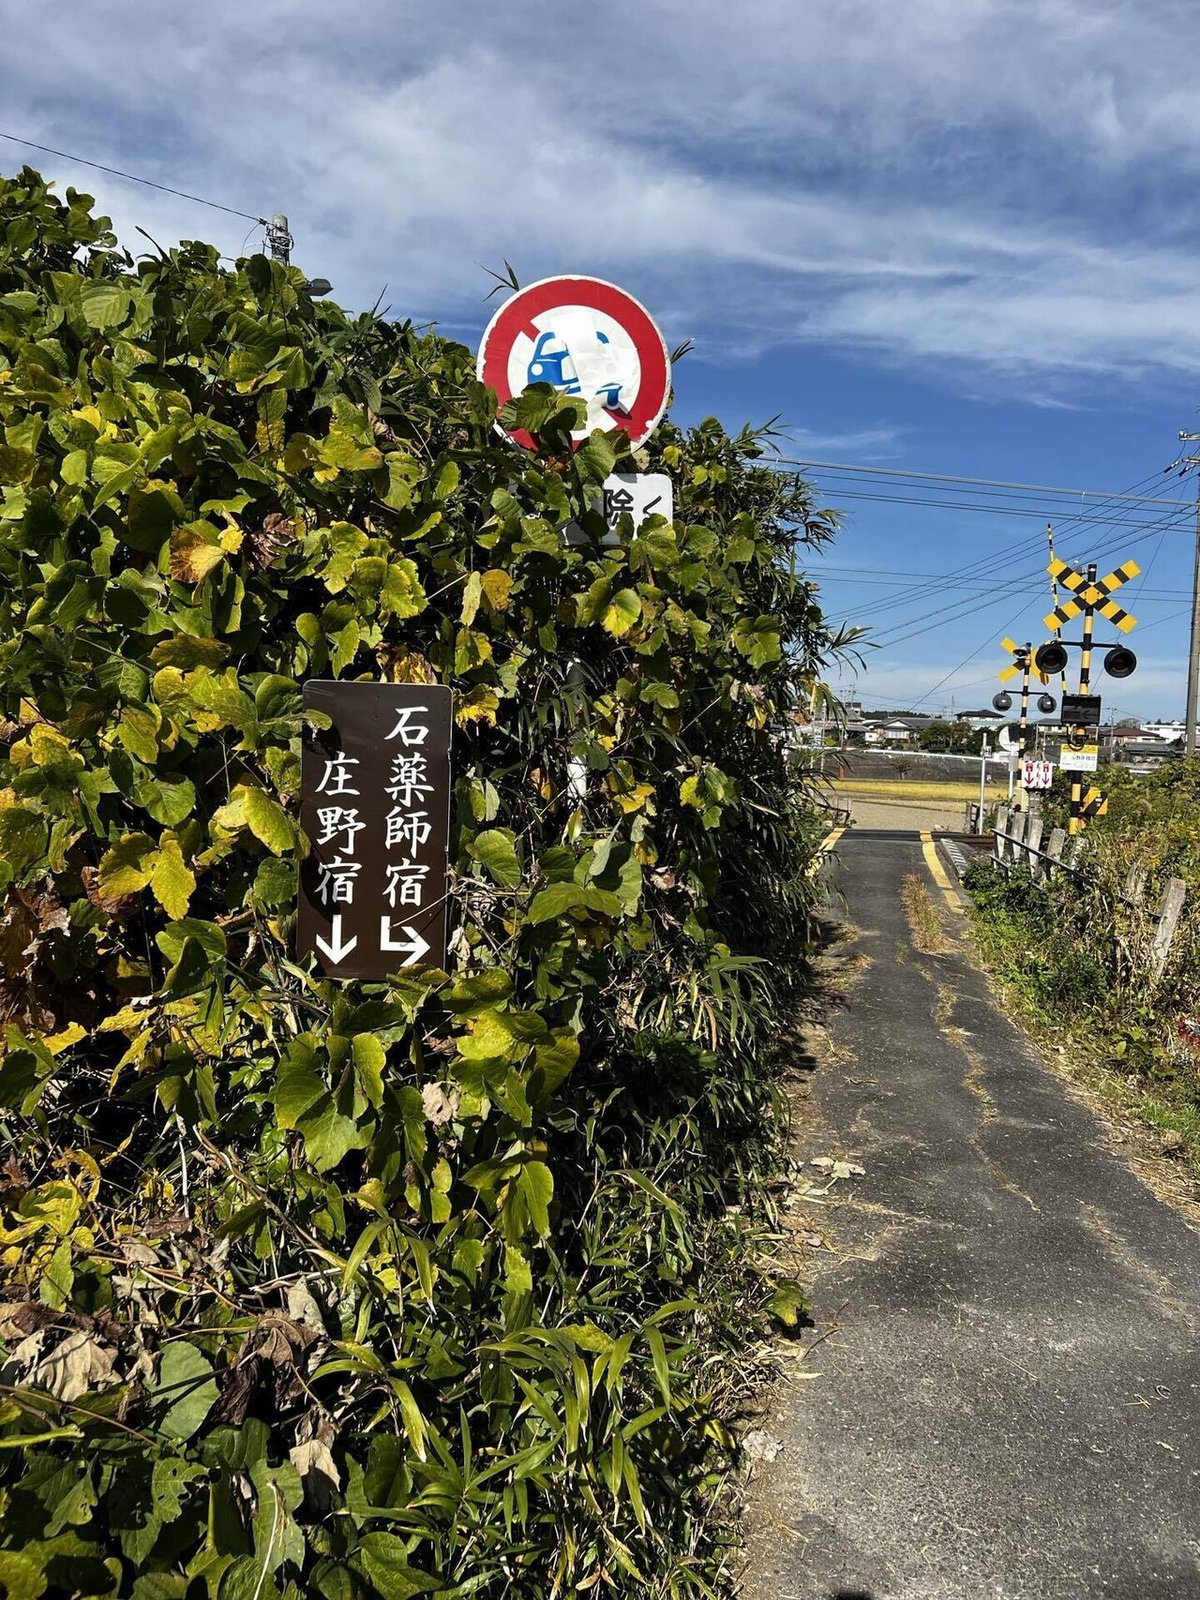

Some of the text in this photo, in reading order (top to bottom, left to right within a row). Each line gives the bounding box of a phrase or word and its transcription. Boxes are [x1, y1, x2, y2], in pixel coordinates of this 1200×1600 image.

[314, 751, 367, 905] 庄野宿
[382, 705, 434, 907] 石薬師宿
